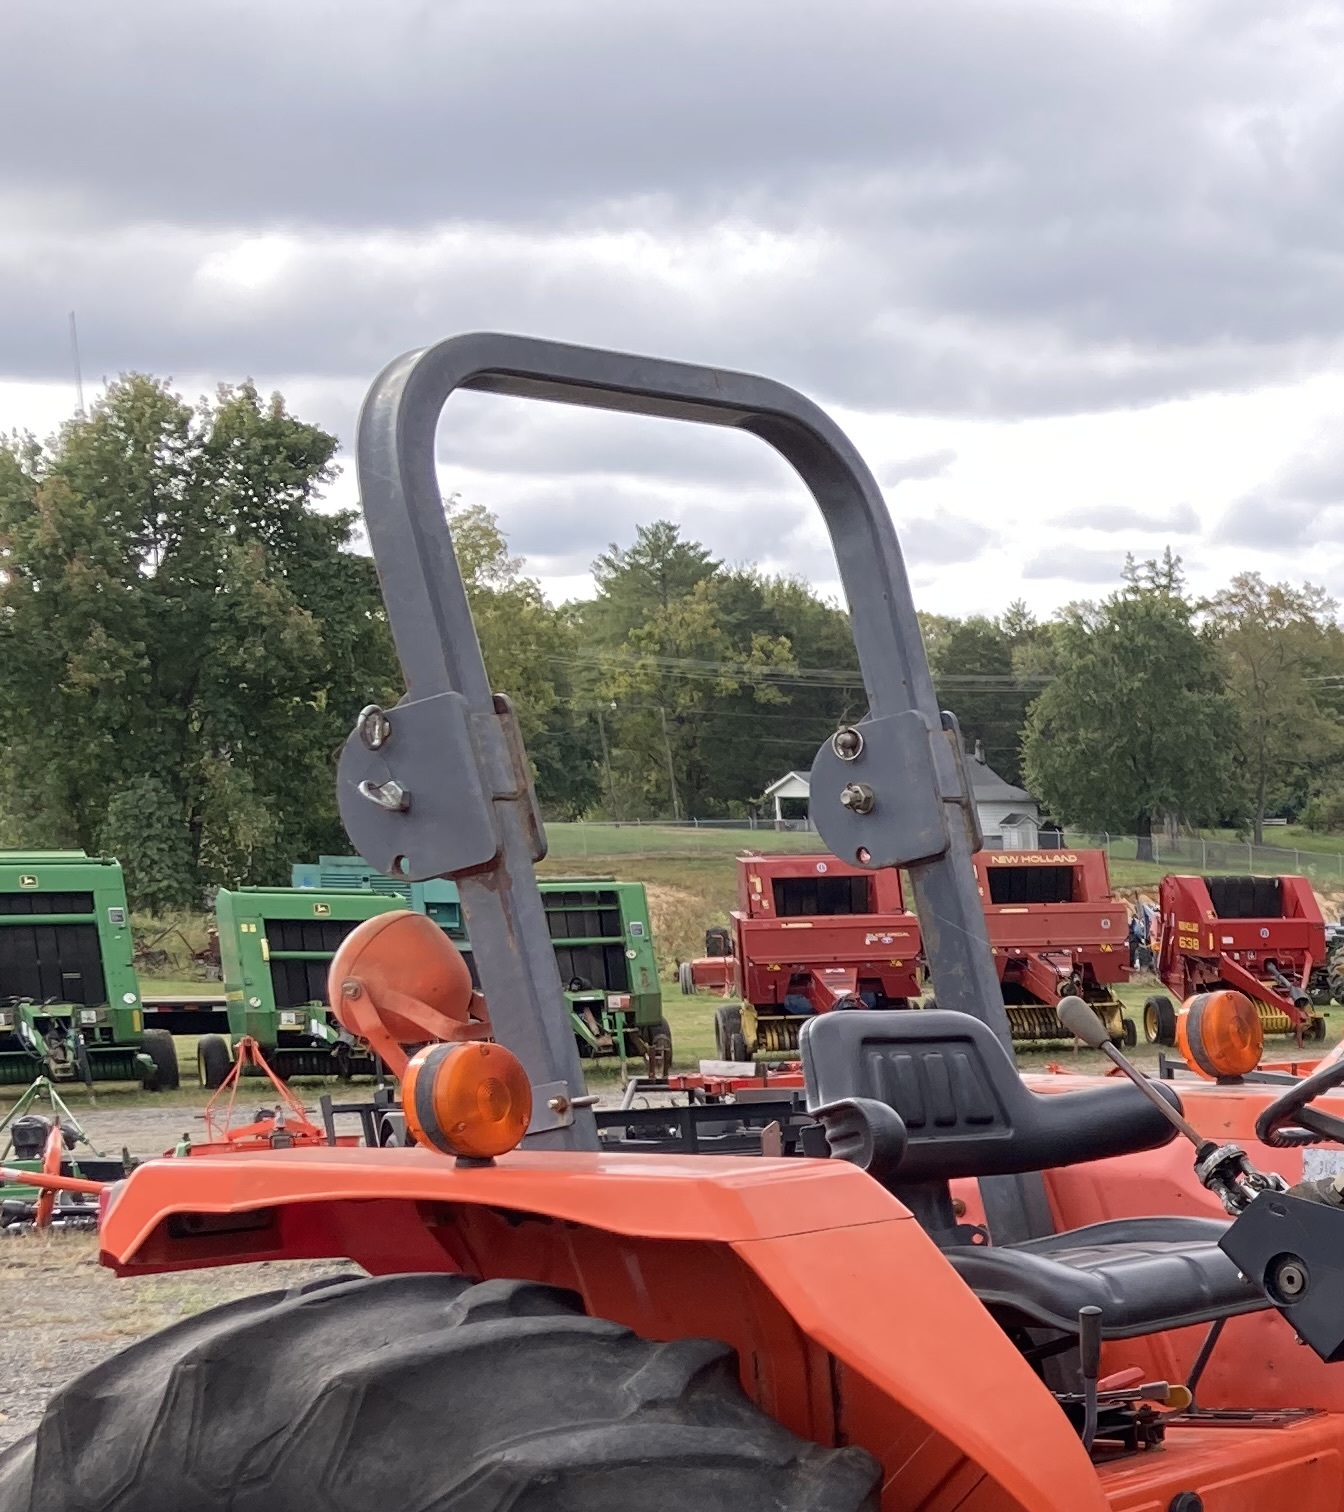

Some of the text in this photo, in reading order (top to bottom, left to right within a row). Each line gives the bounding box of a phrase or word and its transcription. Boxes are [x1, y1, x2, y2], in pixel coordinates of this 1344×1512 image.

[991, 854, 1078, 864] NEW HOLLAND
[1178, 936, 1199, 950] 638
